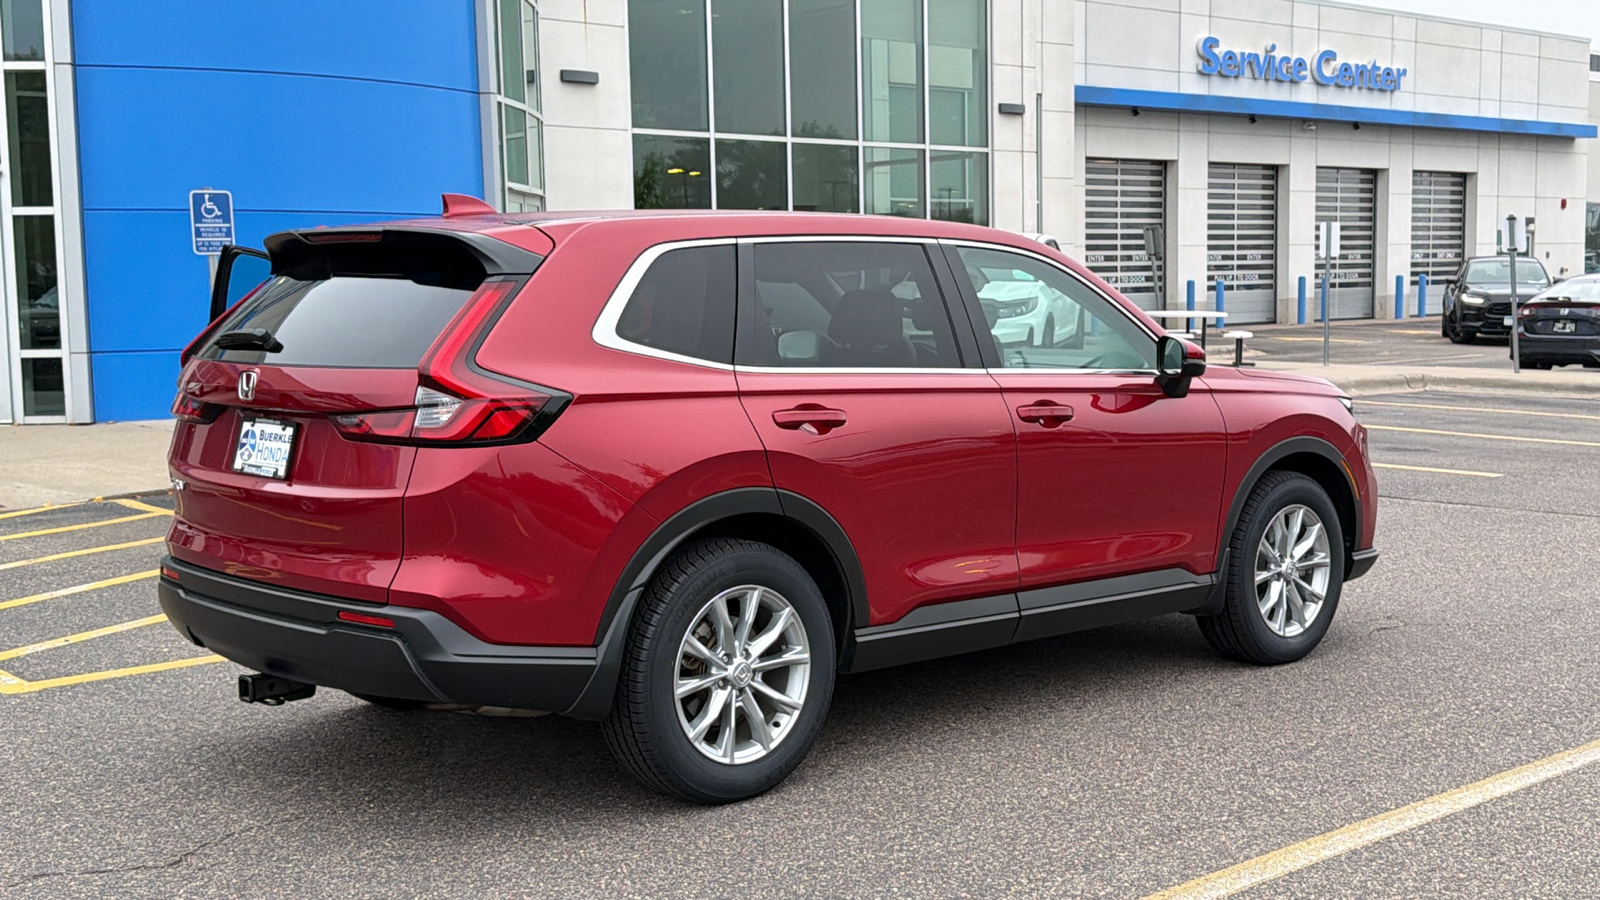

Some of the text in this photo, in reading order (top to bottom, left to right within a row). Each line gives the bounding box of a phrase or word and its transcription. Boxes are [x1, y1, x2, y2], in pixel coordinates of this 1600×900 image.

[1197, 36, 1408, 91] Service Center
[259, 429, 292, 443] BUERKLE
[255, 442, 288, 462] HONDA
